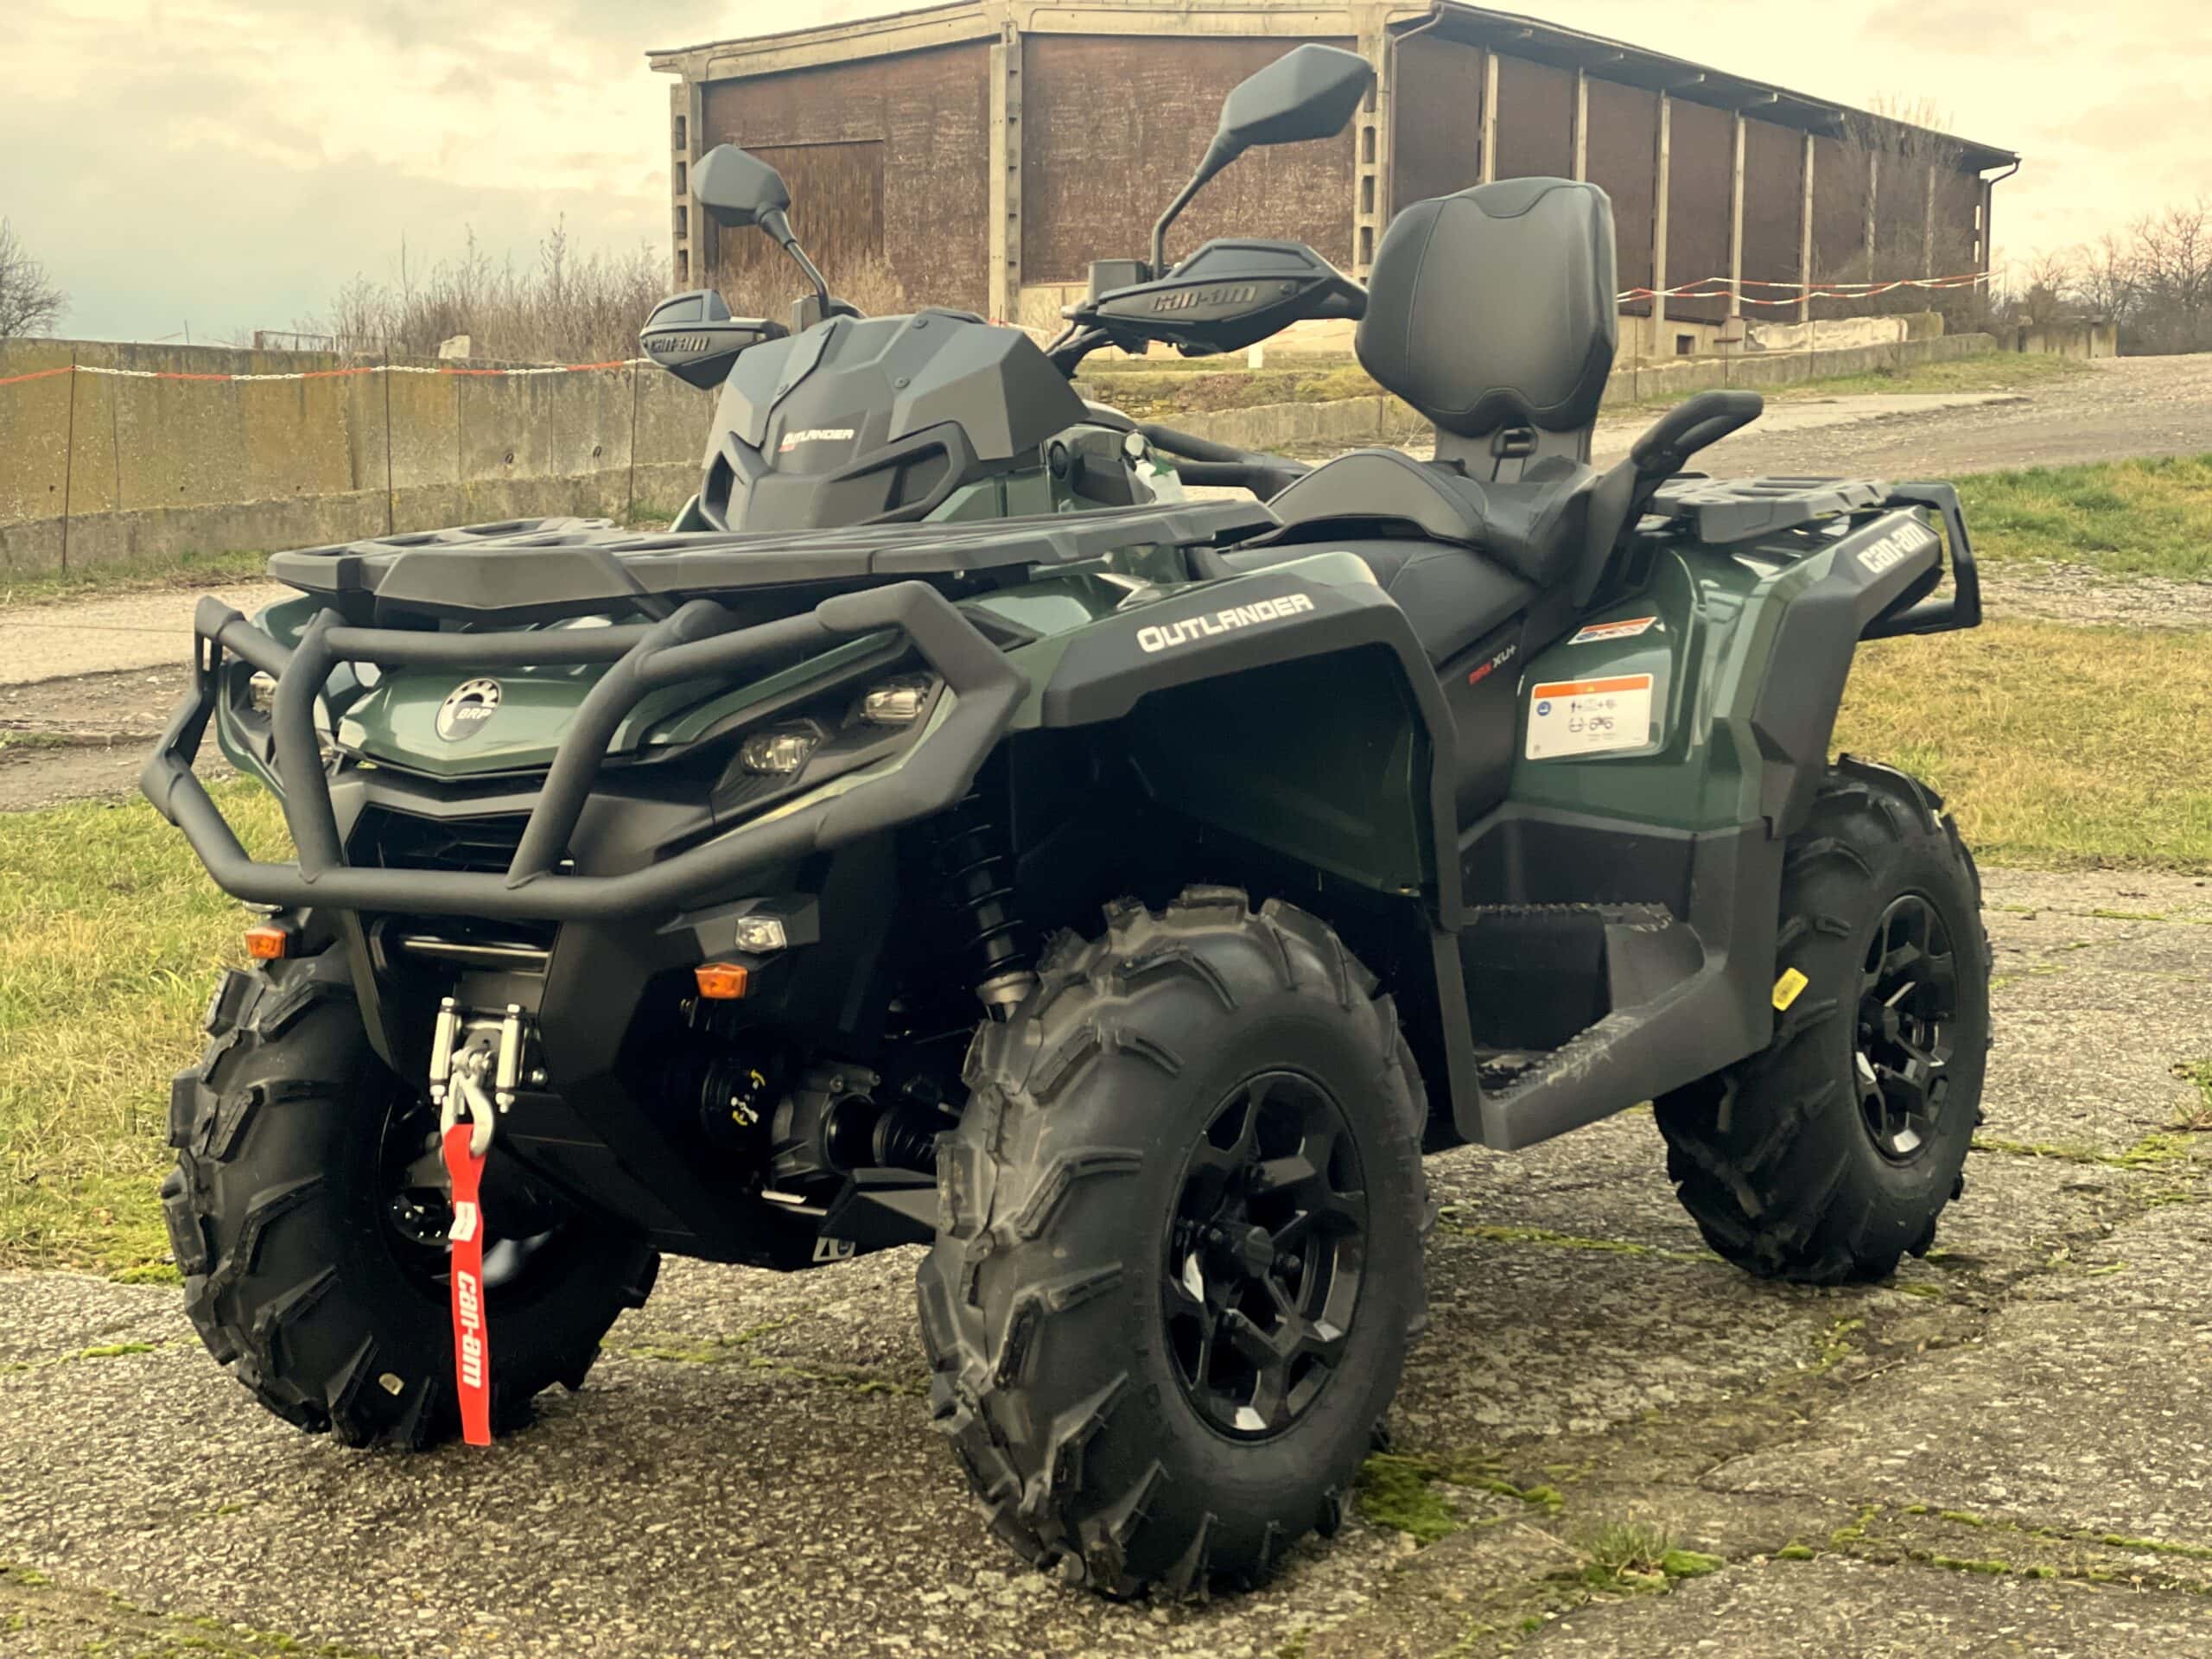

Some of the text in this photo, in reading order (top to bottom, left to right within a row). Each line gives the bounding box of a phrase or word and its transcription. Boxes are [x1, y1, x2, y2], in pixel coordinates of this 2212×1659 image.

[782, 429, 855, 445] OUTLANDER
[1136, 593, 1315, 653] OUTLANDER
[456, 707, 493, 720] BRP
